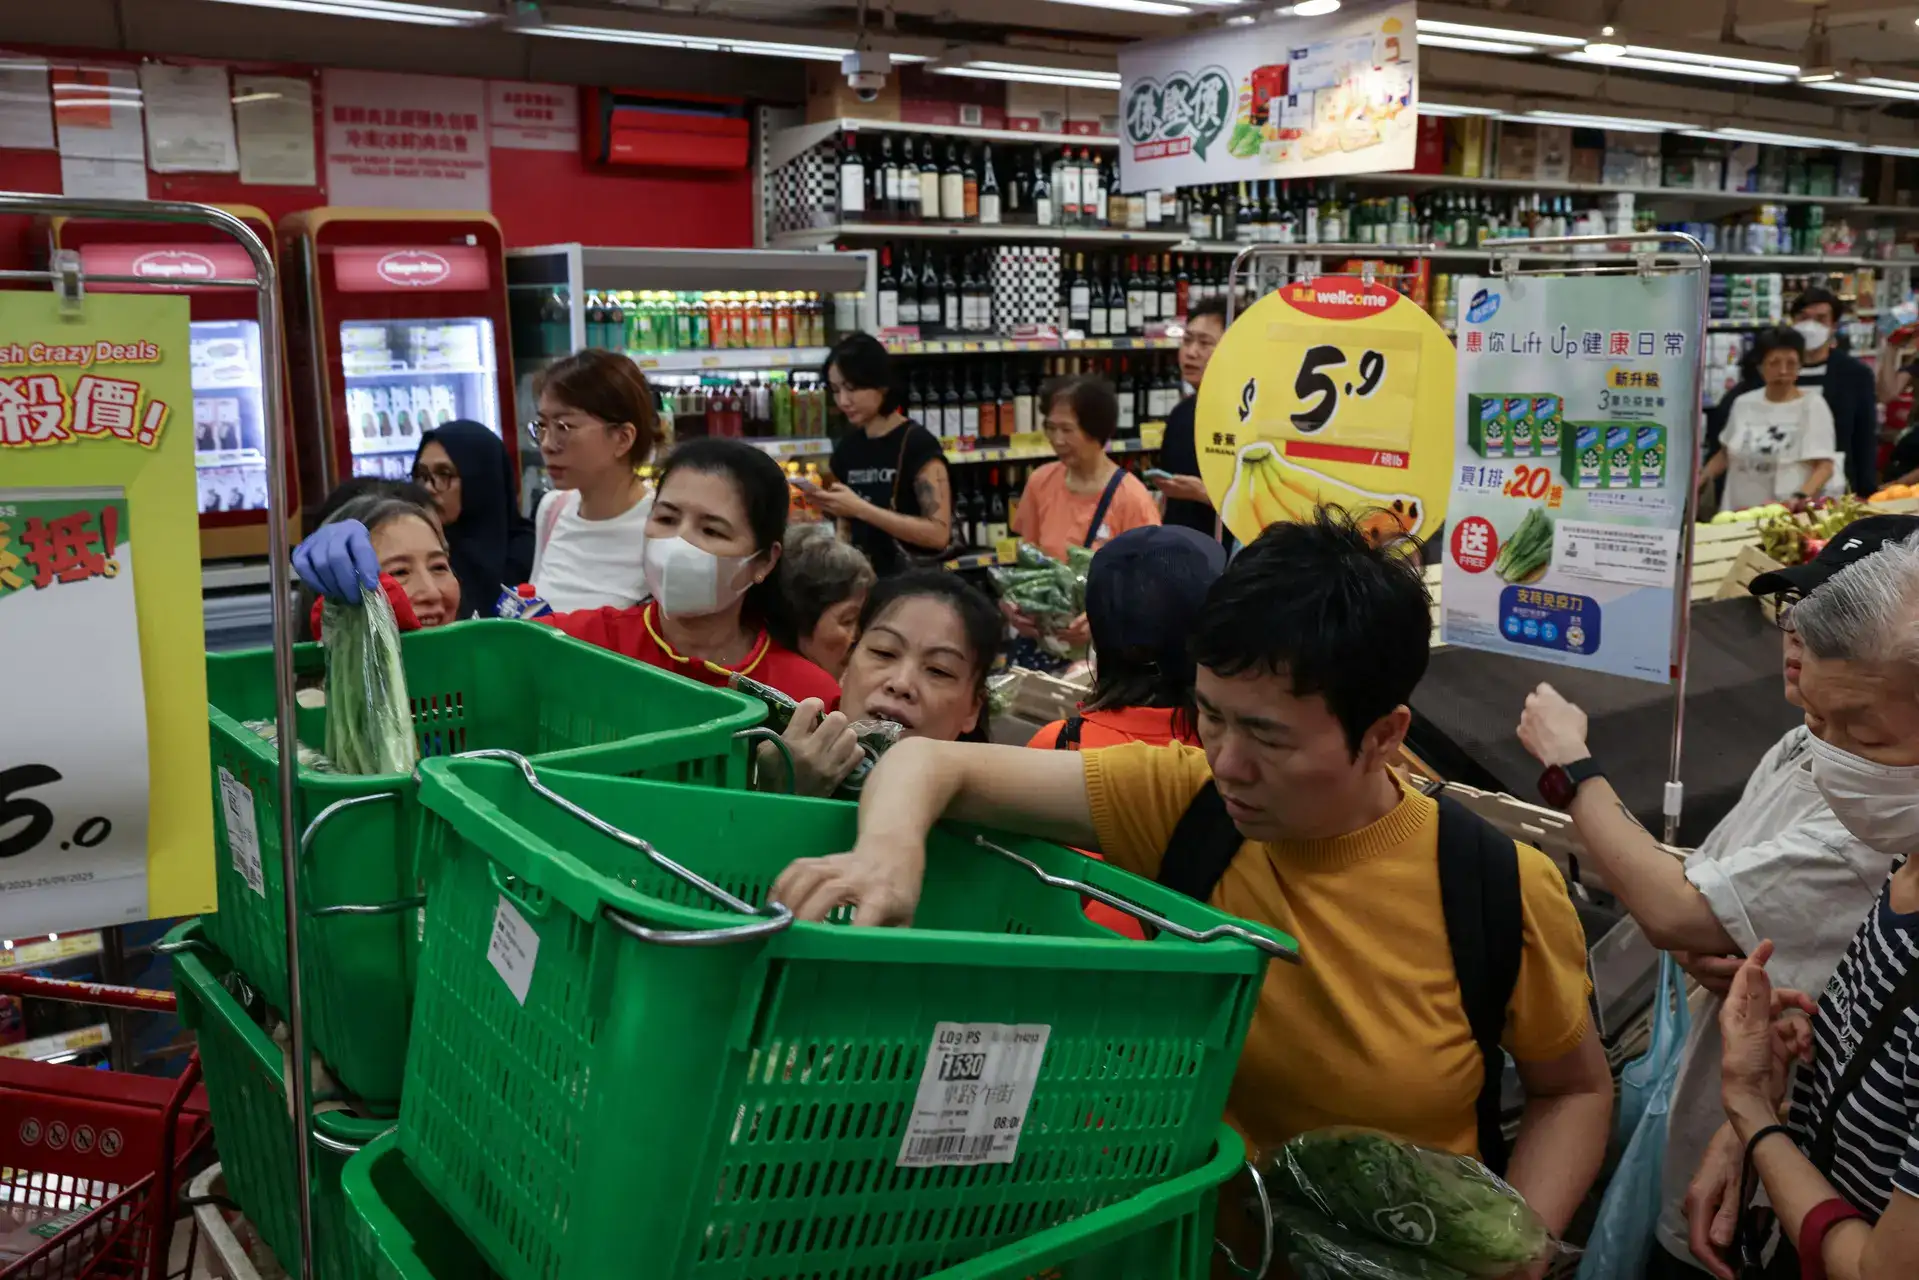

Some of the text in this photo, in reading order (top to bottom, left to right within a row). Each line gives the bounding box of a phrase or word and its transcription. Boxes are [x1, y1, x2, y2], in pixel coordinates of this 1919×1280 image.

[1317, 289, 1387, 306] wellcome
[28, 340, 91, 367] Crazy
[95, 339, 159, 361] Deals
[1289, 344, 1385, 432] 5.9
[1205, 446, 1236, 457] BANANA
[1459, 521, 1489, 557] 送
[1459, 554, 1487, 568] FREE
[943, 1053, 985, 1079] 1530
